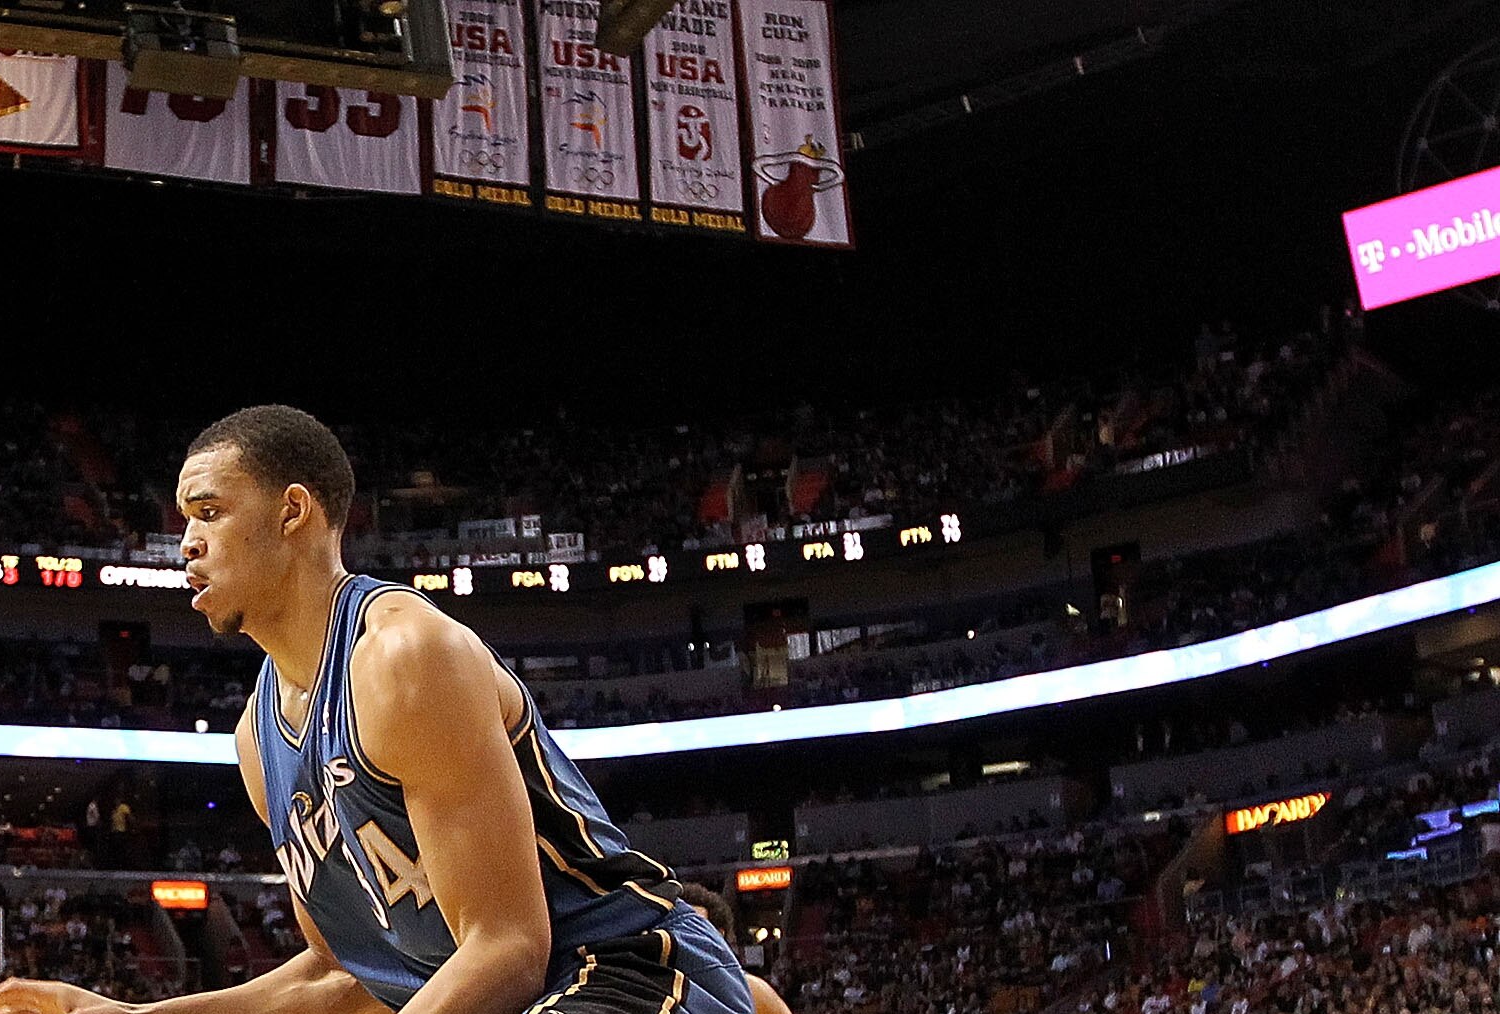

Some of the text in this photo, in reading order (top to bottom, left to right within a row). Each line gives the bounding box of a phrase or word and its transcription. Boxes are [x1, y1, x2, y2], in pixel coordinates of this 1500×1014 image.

[764, 12, 803, 29] RON
[656, 52, 725, 84] USA
[803, 541, 835, 561] FTA
[705, 552, 739, 571] FTM
[413, 574, 448, 591] FGM
[512, 571, 545, 588] FGA
[738, 870, 792, 887] BACARDI
